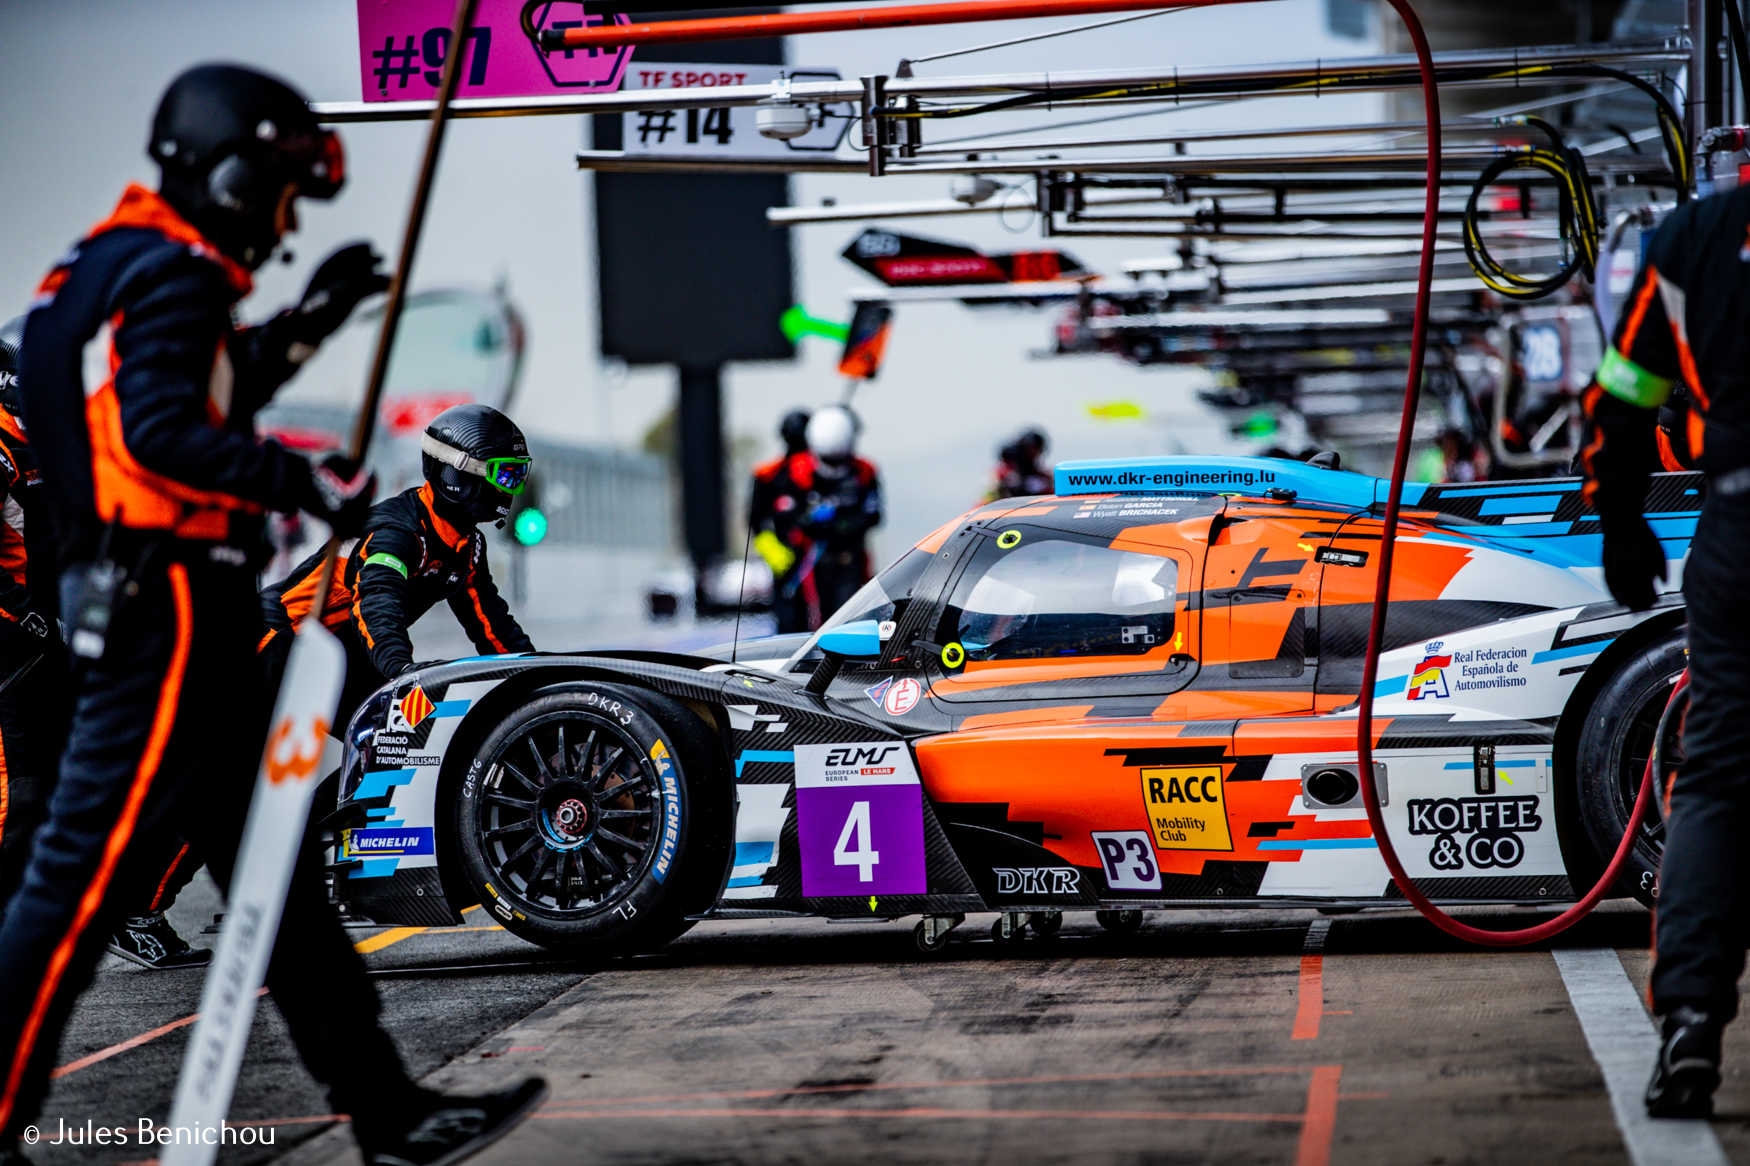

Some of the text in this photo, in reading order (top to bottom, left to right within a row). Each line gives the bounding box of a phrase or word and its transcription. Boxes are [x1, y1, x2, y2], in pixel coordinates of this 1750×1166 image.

[639, 71, 746, 88] TF SPORT
[637, 109, 733, 144] #14
[1068, 470, 1276, 487] www.dkr-engineering.lu
[1454, 647, 1528, 663] Real Federacion
[1462, 662, 1519, 679] Española de
[1454, 676, 1527, 691] Automovilismo
[376, 745, 407, 755] CATALANA
[375, 756, 441, 765] D'AUTOMOBILISME
[1149, 776, 1218, 804] RACC
[1412, 800, 1537, 831] KOFFEE
[655, 776, 679, 875] MICHELIN
[1156, 817, 1206, 832] Mobility
[360, 837, 420, 848] MICHELIN
[833, 800, 880, 883] 4
[1160, 831, 1187, 842] Club
[1470, 837, 1521, 864] CO
[1097, 838, 1156, 882] P3
[992, 867, 1081, 894] DKR
